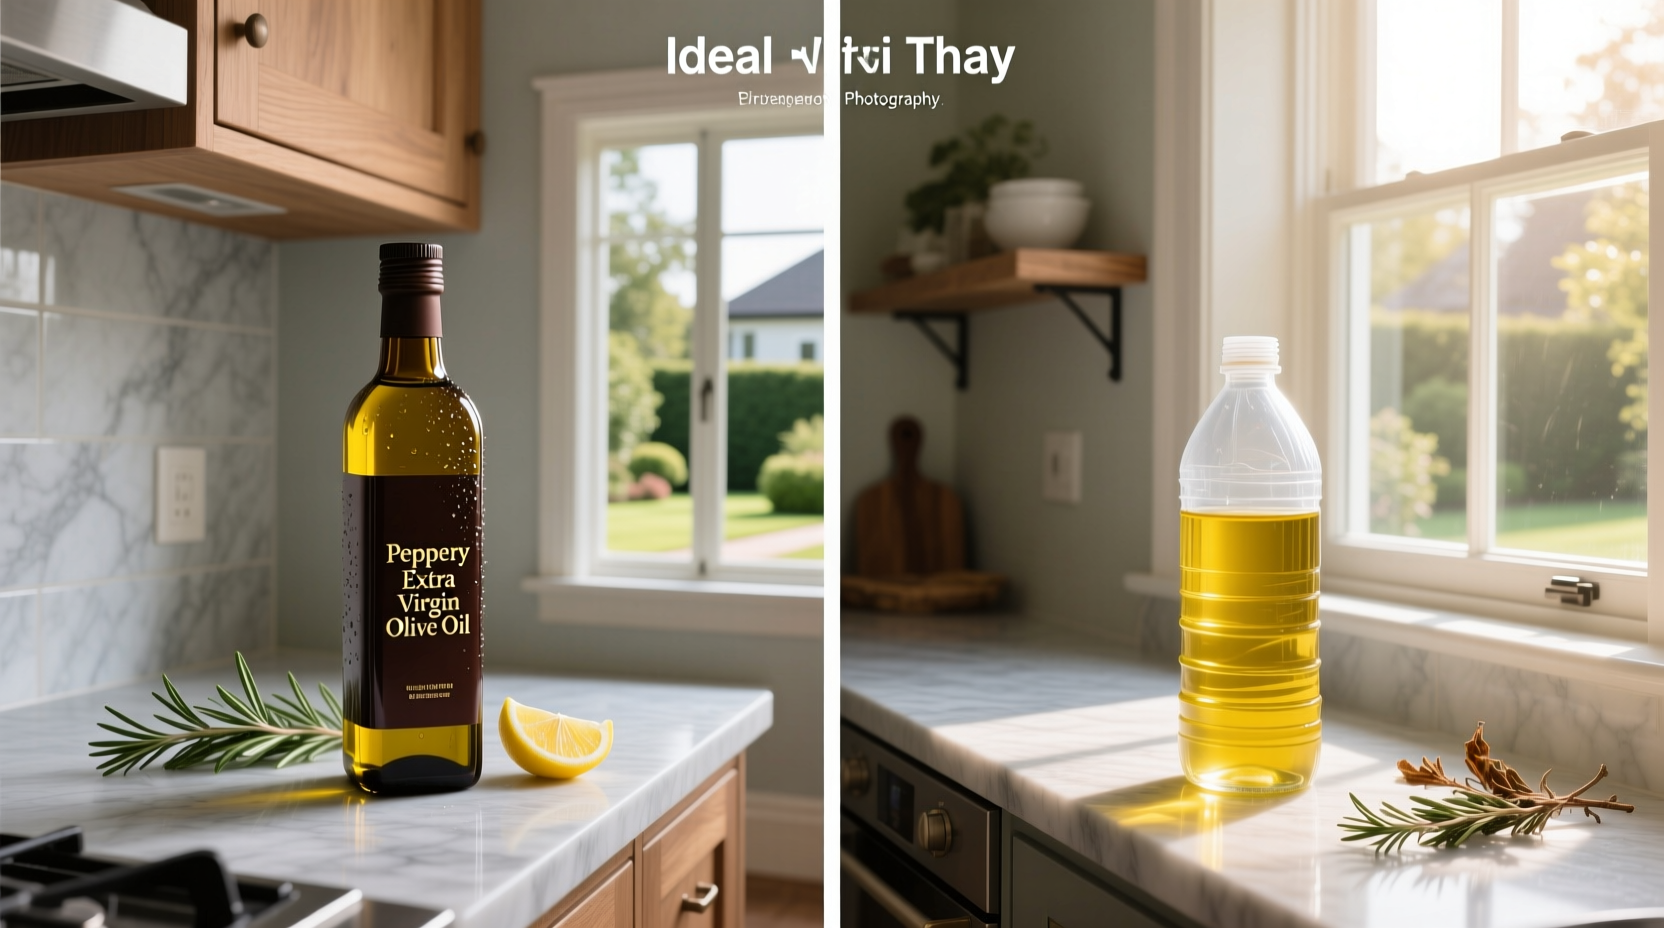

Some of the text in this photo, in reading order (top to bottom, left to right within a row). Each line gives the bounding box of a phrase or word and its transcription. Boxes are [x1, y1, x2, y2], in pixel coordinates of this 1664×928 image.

[385, 543, 471, 569] Peppery
[402, 569, 456, 590] Extra
[396, 591, 460, 619] Virgin
[385, 613, 471, 638] Olive Oil
